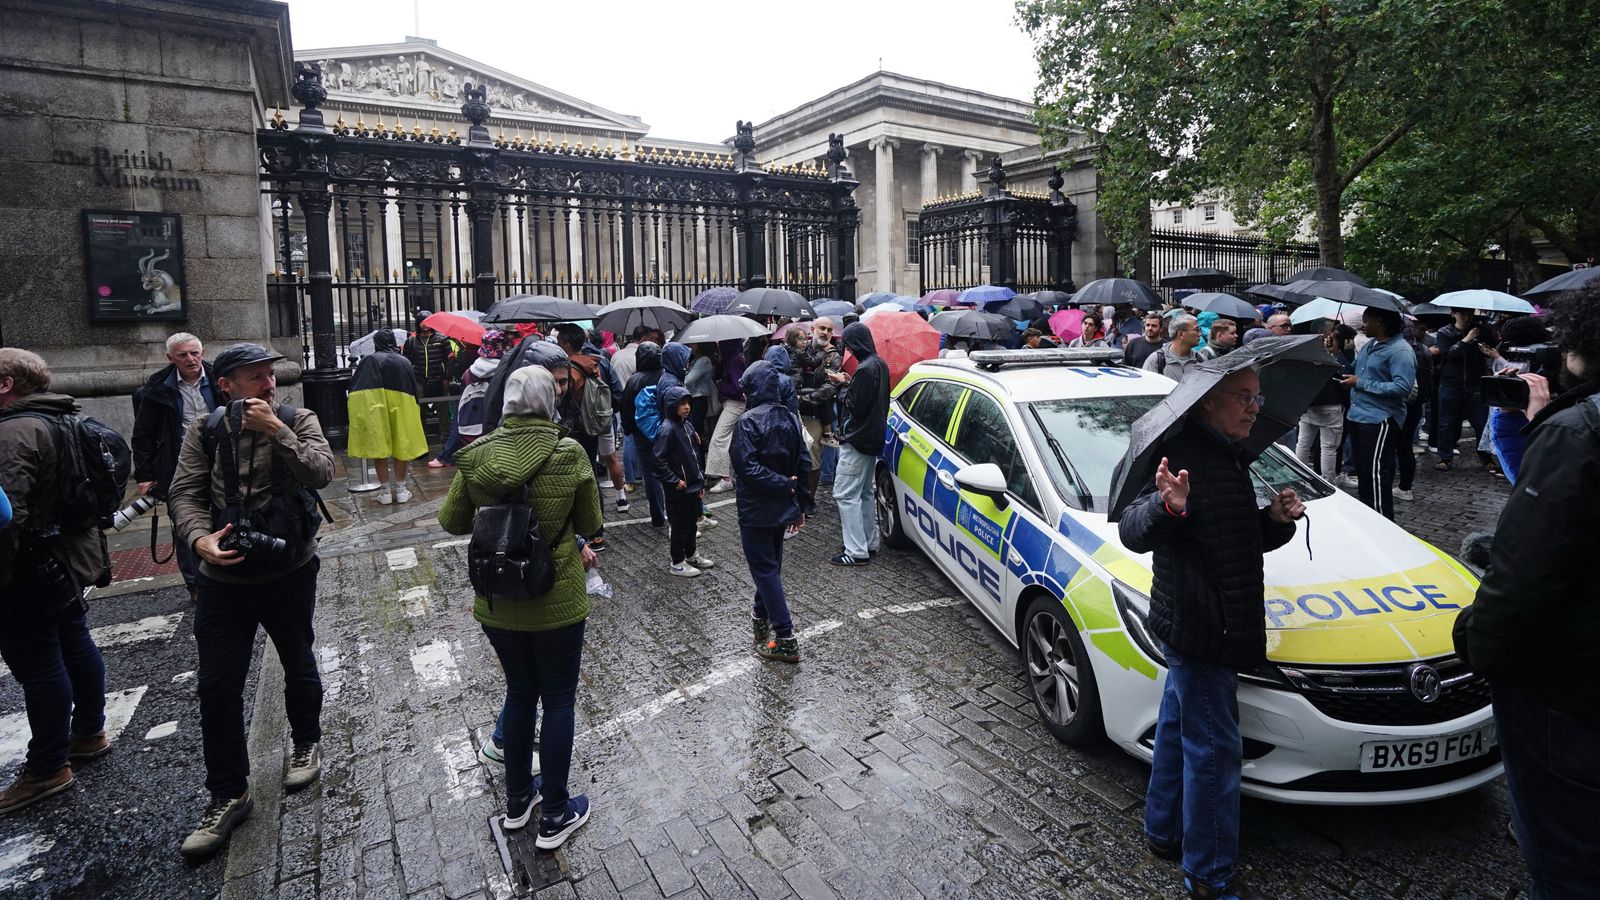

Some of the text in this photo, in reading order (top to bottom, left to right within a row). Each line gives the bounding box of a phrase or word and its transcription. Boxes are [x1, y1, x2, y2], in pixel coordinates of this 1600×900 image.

[54, 147, 172, 170] The British
[95, 168, 202, 192] Museum
[972, 513, 1000, 538] METROPOLITAN
[974, 525, 995, 546] POLICE
[905, 493, 1001, 604] POLICE
[1265, 584, 1463, 628] POLICE
[1372, 731, 1483, 769] BX69 FGA
